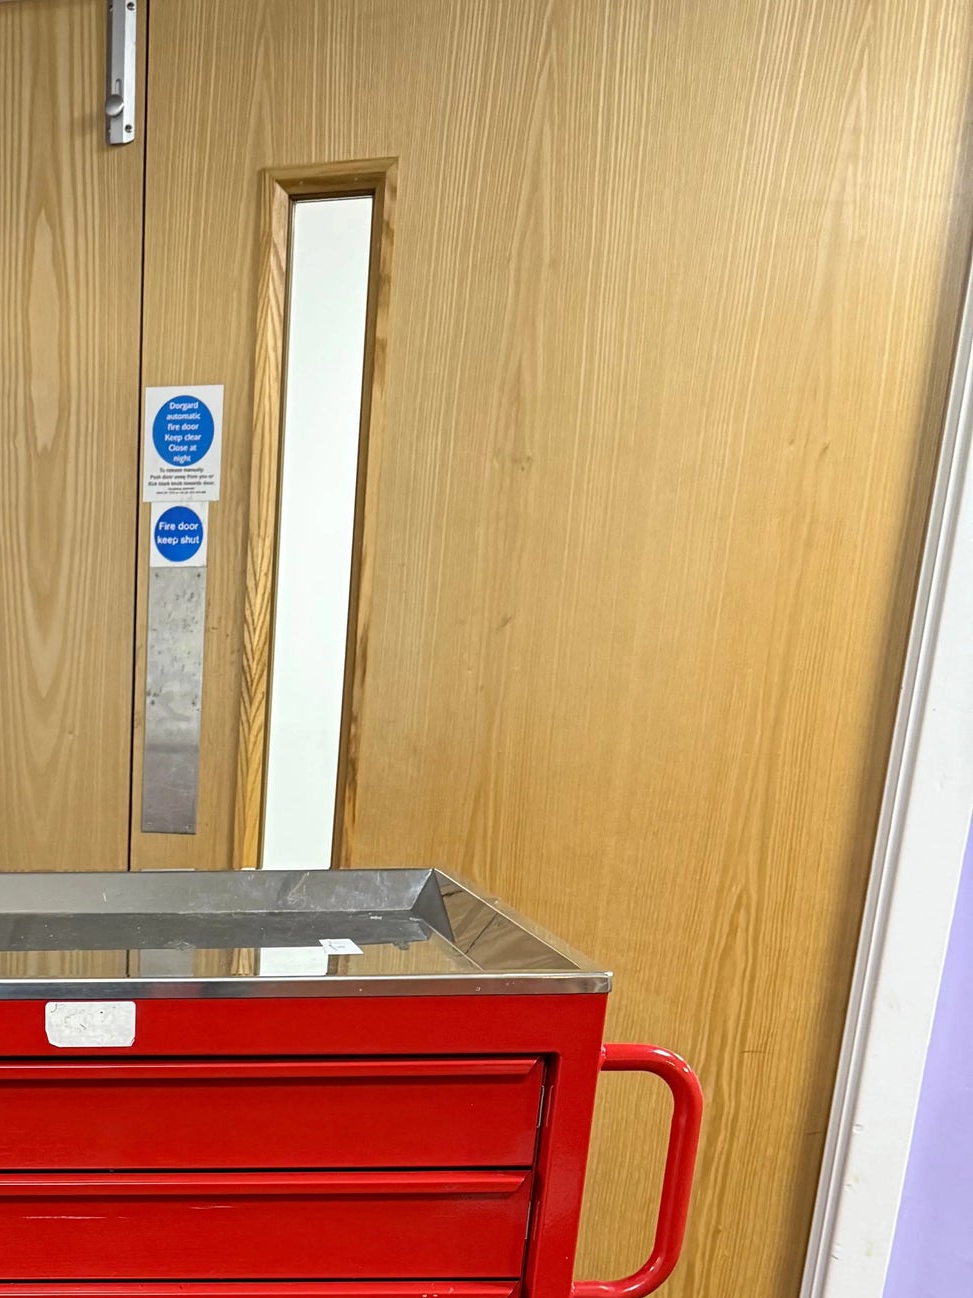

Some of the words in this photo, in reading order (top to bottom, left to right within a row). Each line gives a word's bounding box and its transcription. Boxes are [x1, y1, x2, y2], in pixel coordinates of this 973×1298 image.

[169, 401, 199, 411] Dorgard
[166, 412, 201, 420] automatic
[167, 423, 180, 431] fire
[164, 434, 183, 442] Keep
[168, 444, 188, 452] Close
[173, 454, 191, 464] night
[158, 521, 176, 531] Fire
[177, 521, 199, 531] door
[157, 535, 179, 546] keep
[180, 535, 200, 545] shut
